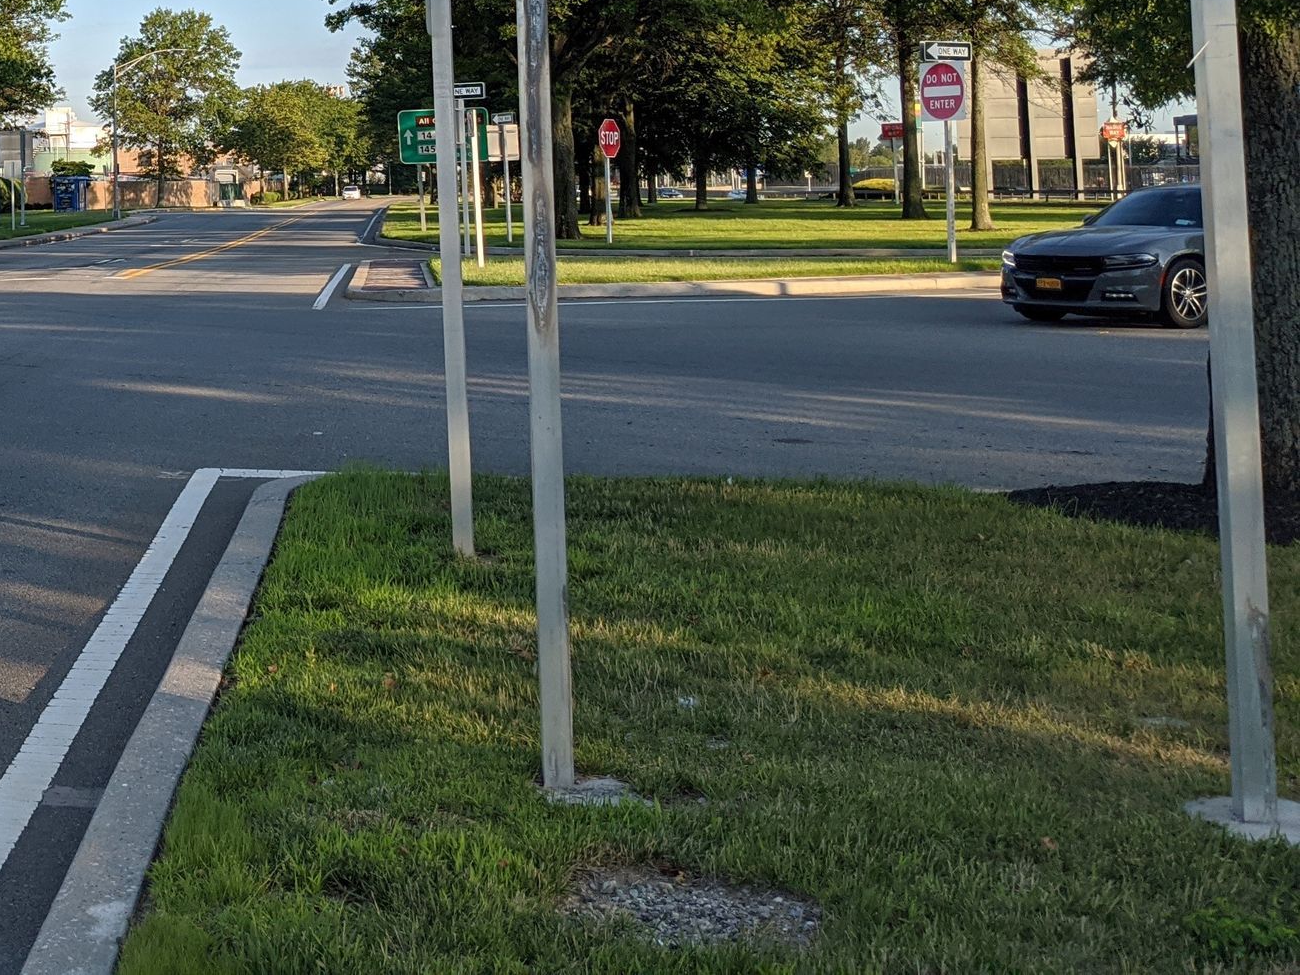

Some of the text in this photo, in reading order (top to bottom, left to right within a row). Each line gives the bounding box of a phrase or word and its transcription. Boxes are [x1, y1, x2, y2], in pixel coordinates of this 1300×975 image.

[926, 73, 957, 84] DO NOT
[465, 86, 479, 94] WAY
[930, 99, 955, 109] ENTER
[418, 116, 430, 125] All
[601, 130, 619, 145] STOP
